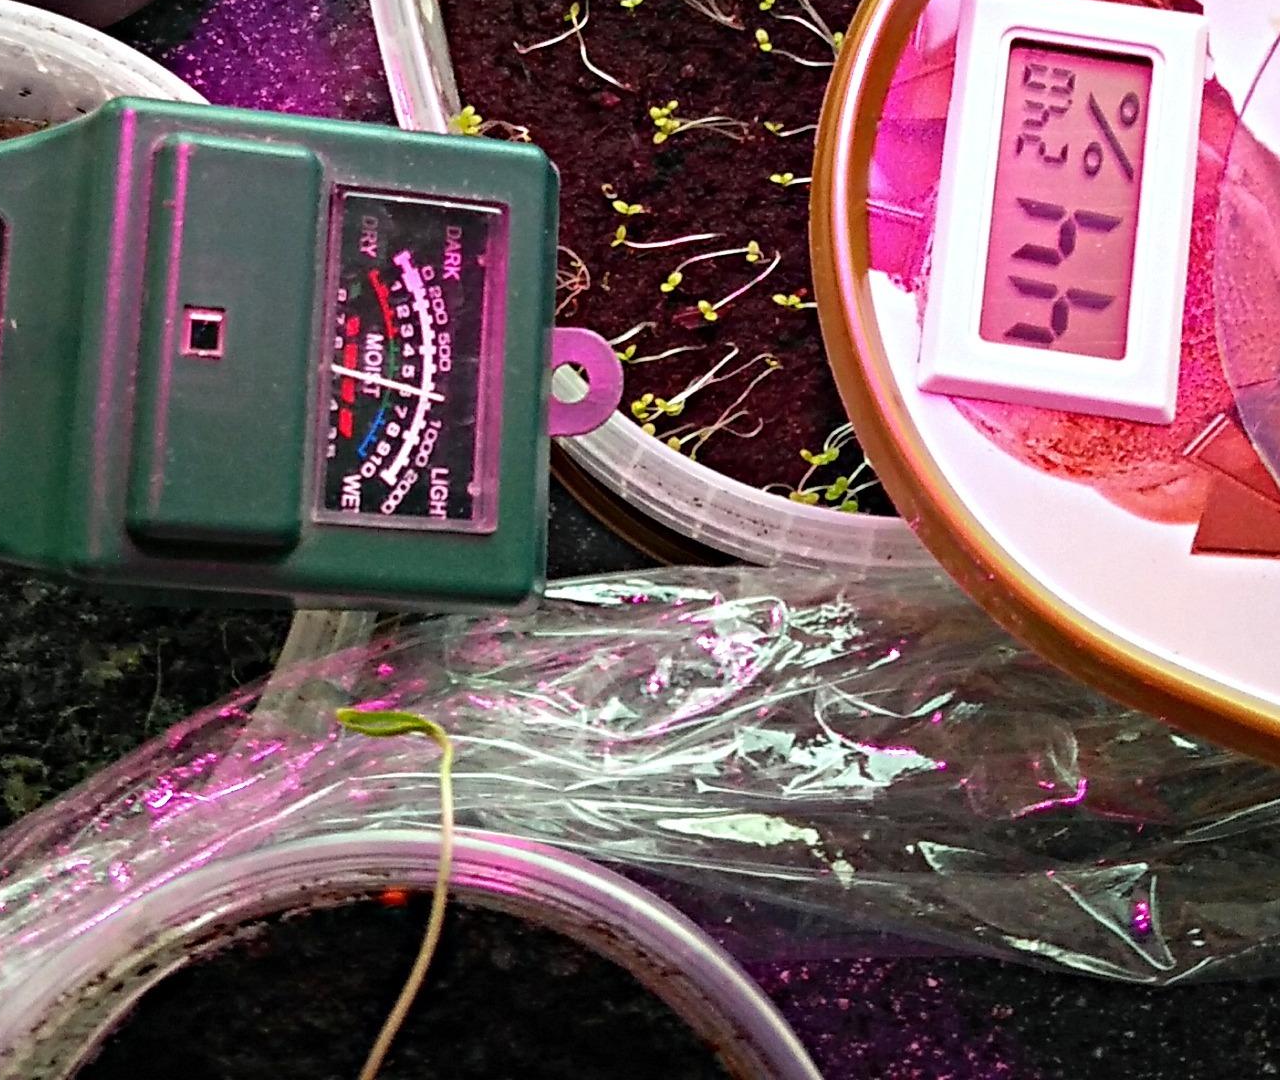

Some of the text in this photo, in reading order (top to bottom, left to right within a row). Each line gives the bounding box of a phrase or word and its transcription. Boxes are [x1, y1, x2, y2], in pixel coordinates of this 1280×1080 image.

[360, 215, 379, 258] DRY
[442, 225, 462, 280] DARK
[1002, 198, 1124, 344] 44
[396, 305, 410, 319] 2
[428, 285, 449, 326] 200
[400, 324, 414, 338] 3
[402, 343, 415, 358] 4
[437, 332, 451, 372] 500
[401, 365, 415, 378] 5
[394, 405, 408, 419] 7
[386, 421, 401, 438] 8
[376, 441, 391, 456] 9
[415, 420, 442, 467] 1000
[360, 455, 383, 479] 10
[380, 469, 418, 514] 2000
